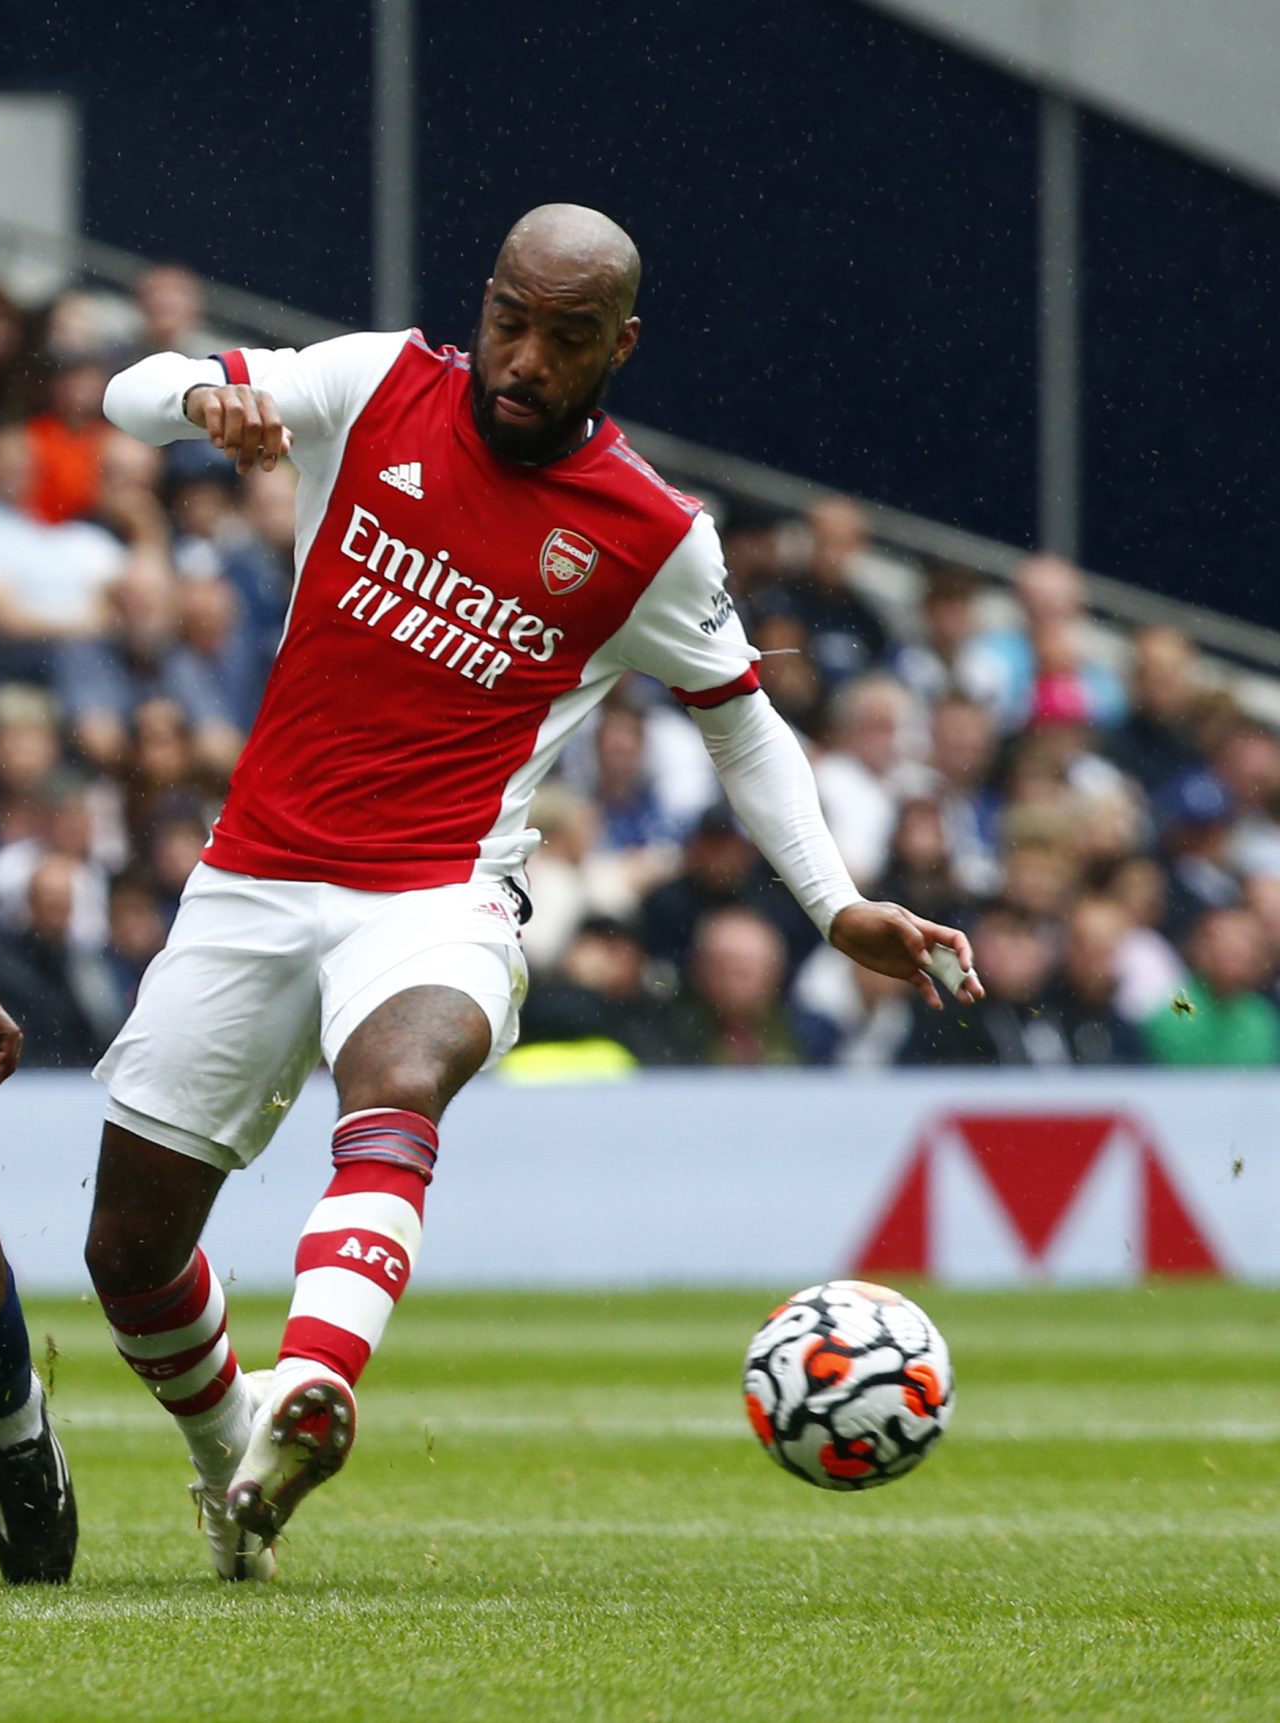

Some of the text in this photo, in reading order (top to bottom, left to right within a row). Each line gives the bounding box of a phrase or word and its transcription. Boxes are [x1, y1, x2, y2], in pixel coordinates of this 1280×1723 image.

[378, 470, 426, 500] adidas
[551, 538, 592, 563] Arsenal
[340, 503, 564, 662] Emirates
[336, 576, 512, 689] FLY BETTER
[336, 1236, 404, 1282] AFC
